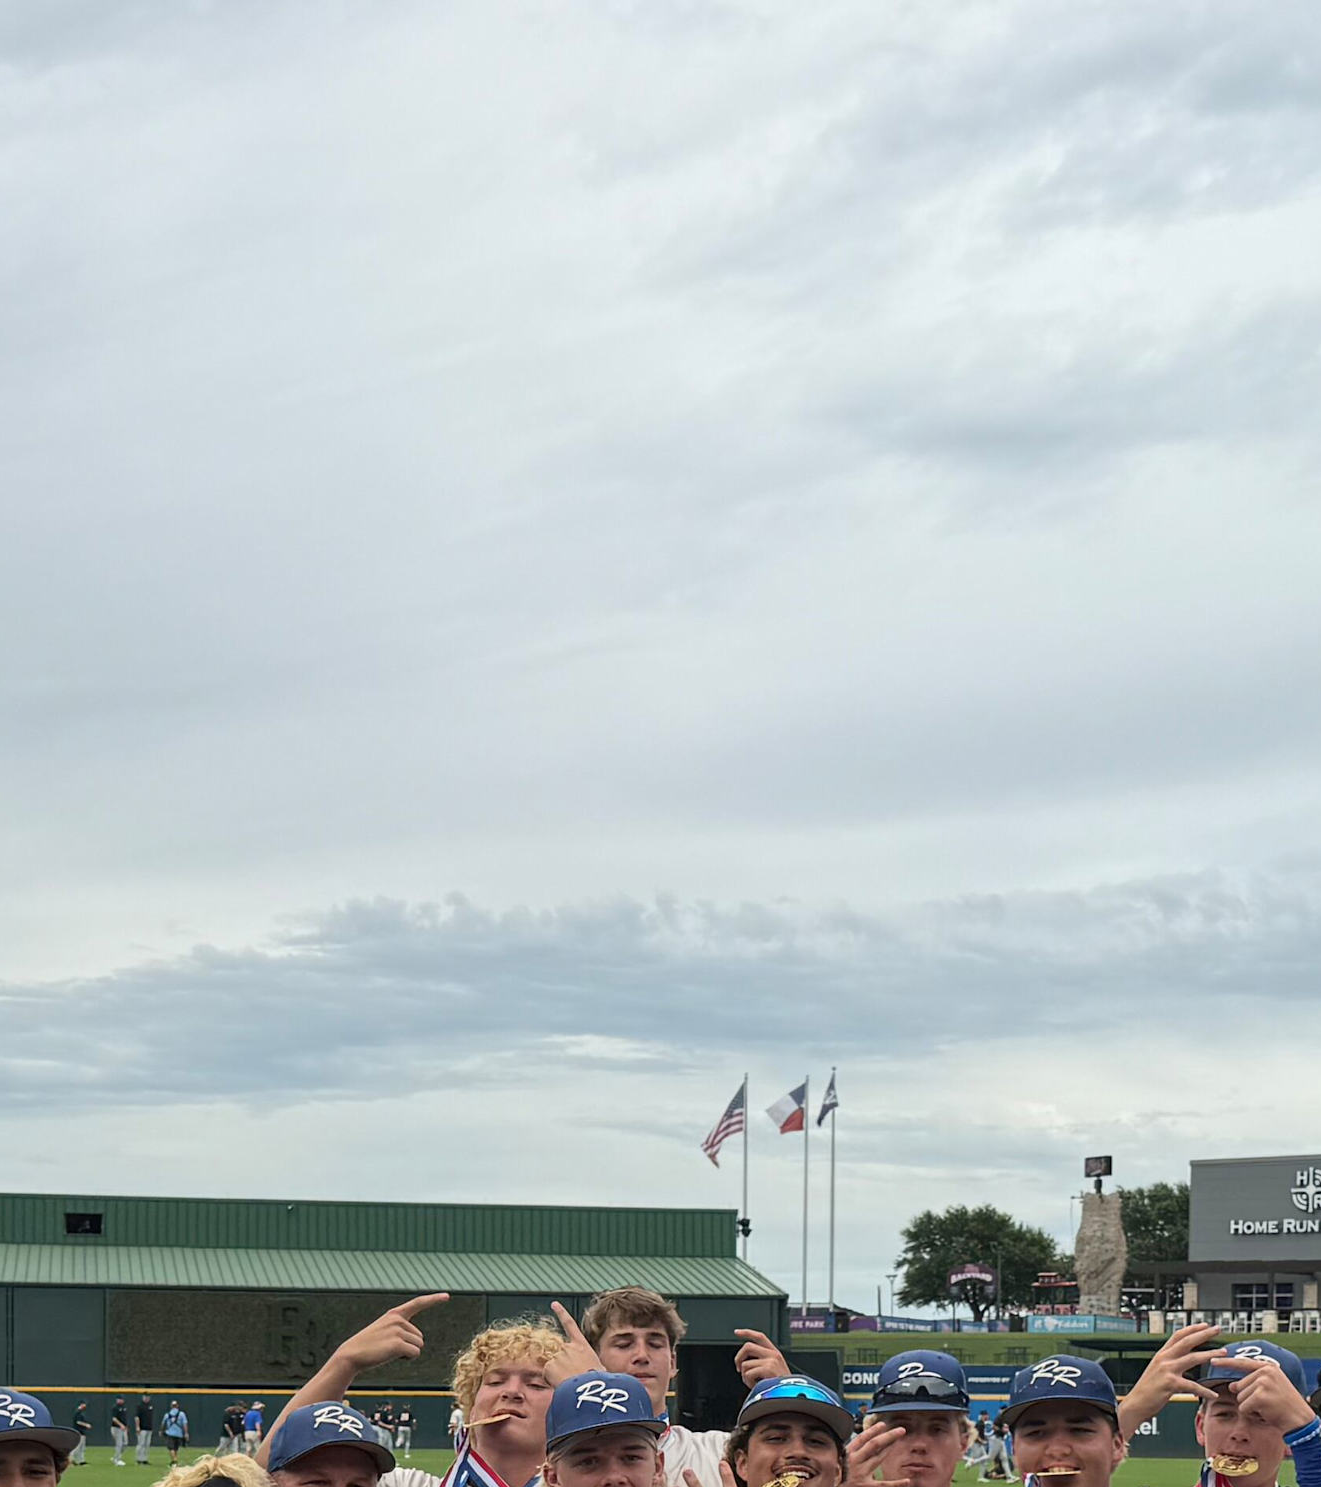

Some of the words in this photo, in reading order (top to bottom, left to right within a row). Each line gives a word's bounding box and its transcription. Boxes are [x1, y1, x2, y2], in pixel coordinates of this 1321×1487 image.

[1230, 1219, 1278, 1234] HOME
[1283, 1218, 1320, 1233] RUN
[1030, 1359, 1082, 1388] RR
[575, 1380, 629, 1413] RR
[313, 1405, 364, 1438] RR
